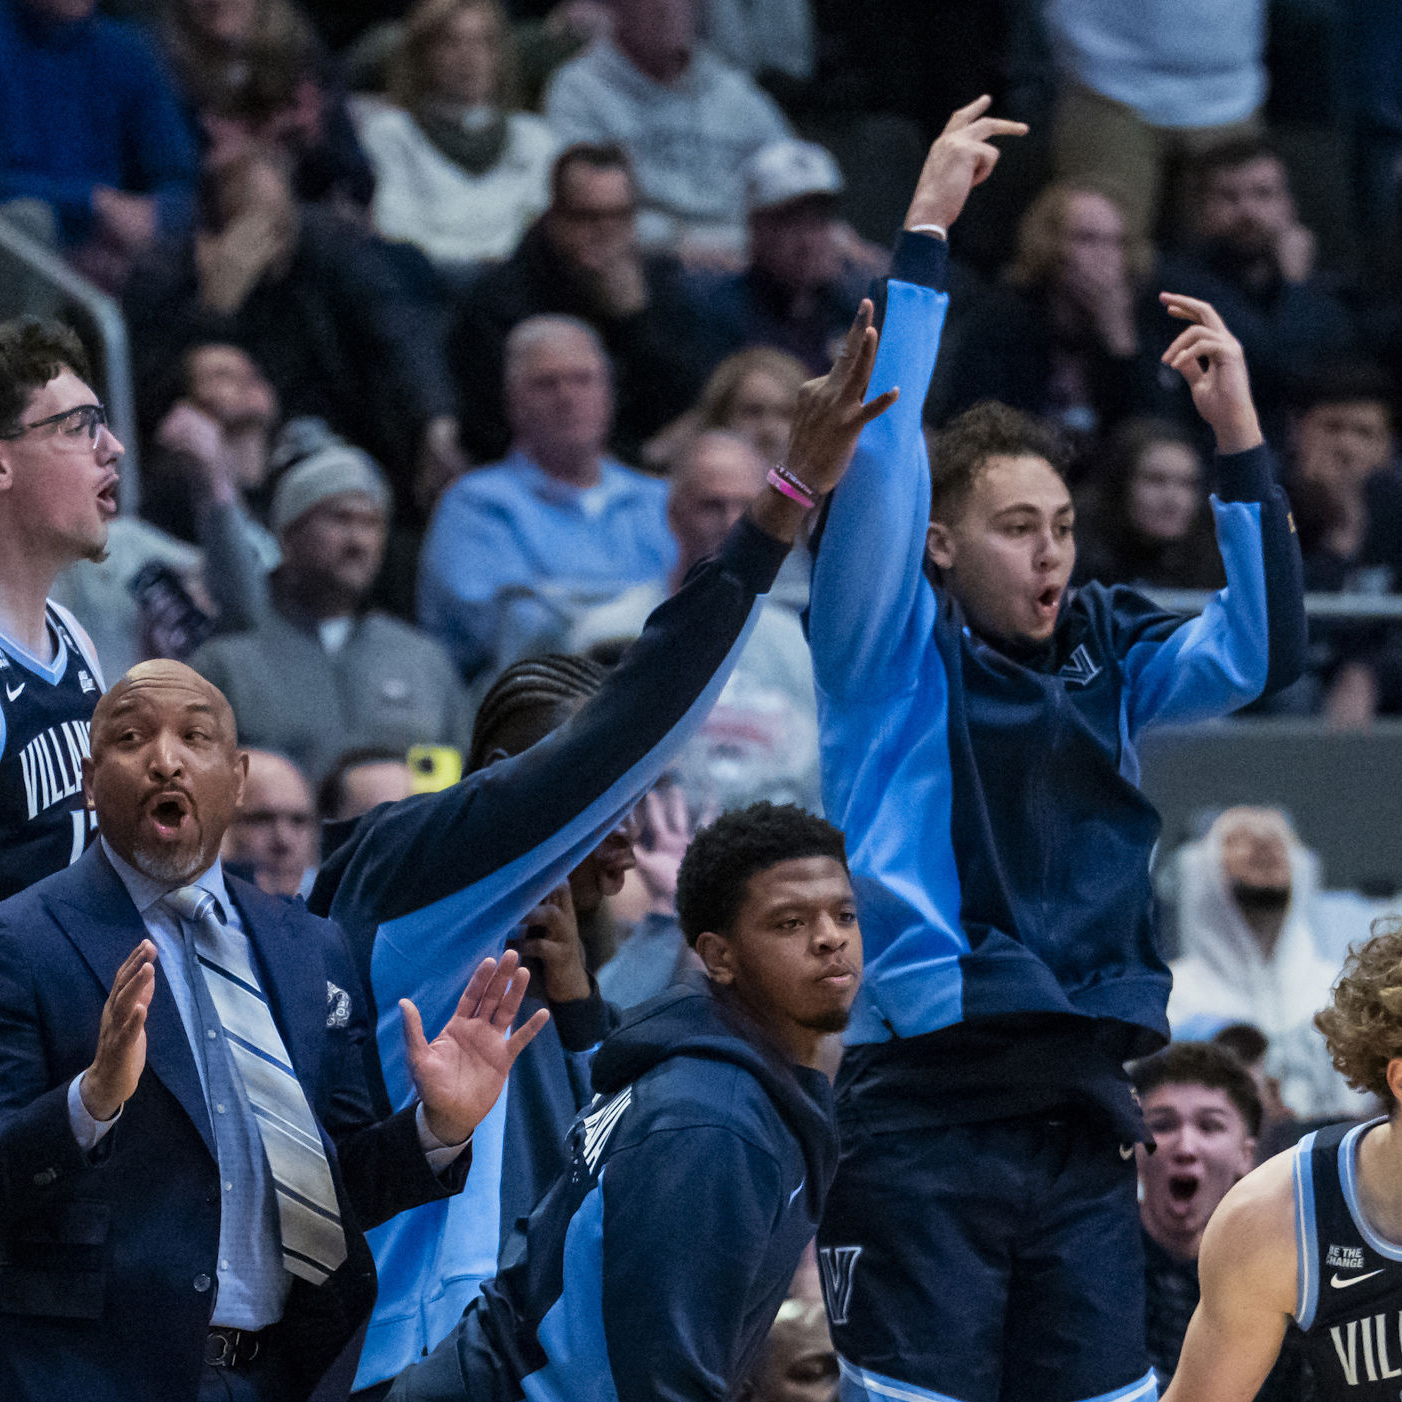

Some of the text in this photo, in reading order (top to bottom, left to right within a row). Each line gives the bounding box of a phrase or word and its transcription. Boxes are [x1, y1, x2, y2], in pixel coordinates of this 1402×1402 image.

[1328, 1244, 1364, 1259] BE THE
[1326, 1256, 1364, 1269] CHANGE
